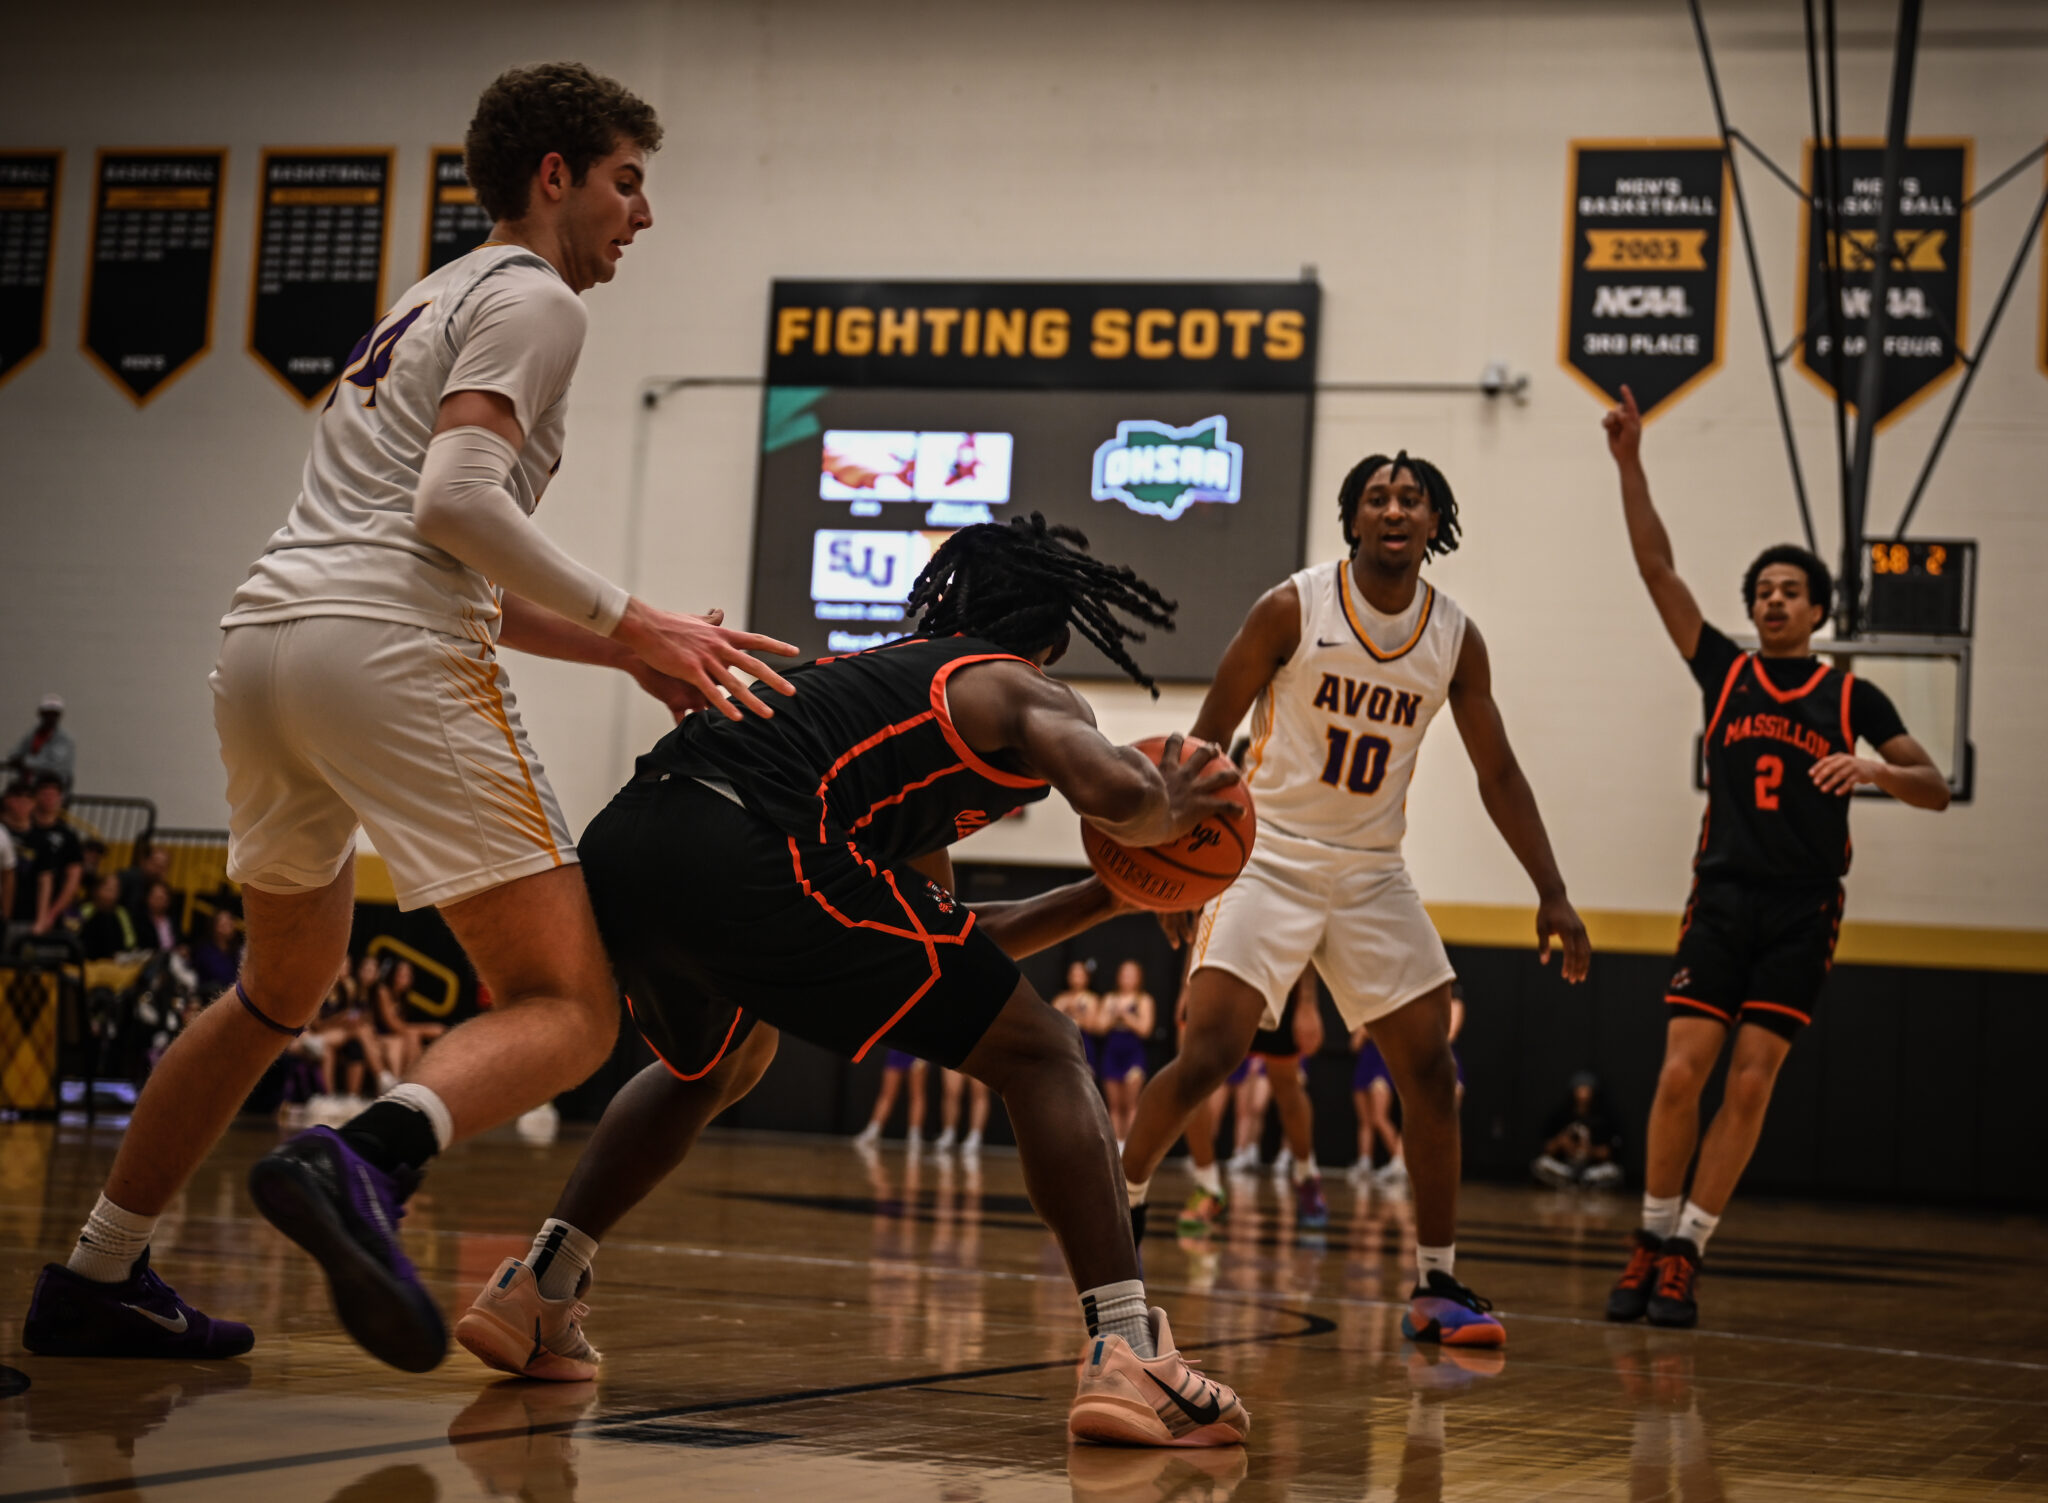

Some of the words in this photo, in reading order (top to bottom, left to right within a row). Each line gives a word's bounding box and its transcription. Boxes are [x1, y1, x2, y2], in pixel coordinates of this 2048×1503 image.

[1615, 177, 1683, 196] MEN'S
[1578, 196, 1716, 217] BASKETBALL
[1611, 238, 1681, 262] 2003
[1592, 286, 1687, 318] NCAA
[776, 306, 1071, 358] FIGHTING
[1091, 308, 1307, 360] SCOTS
[1584, 333, 1628, 355] 3RD
[1630, 333, 1699, 355] PLACE
[1882, 334, 1942, 356] FOUR
[1103, 444, 1231, 491] OHSAA
[1313, 671, 1423, 728] AVON
[1724, 712, 1831, 760] MASSILLON
[1318, 724, 1393, 797] 10
[1754, 753, 1785, 811] 2
